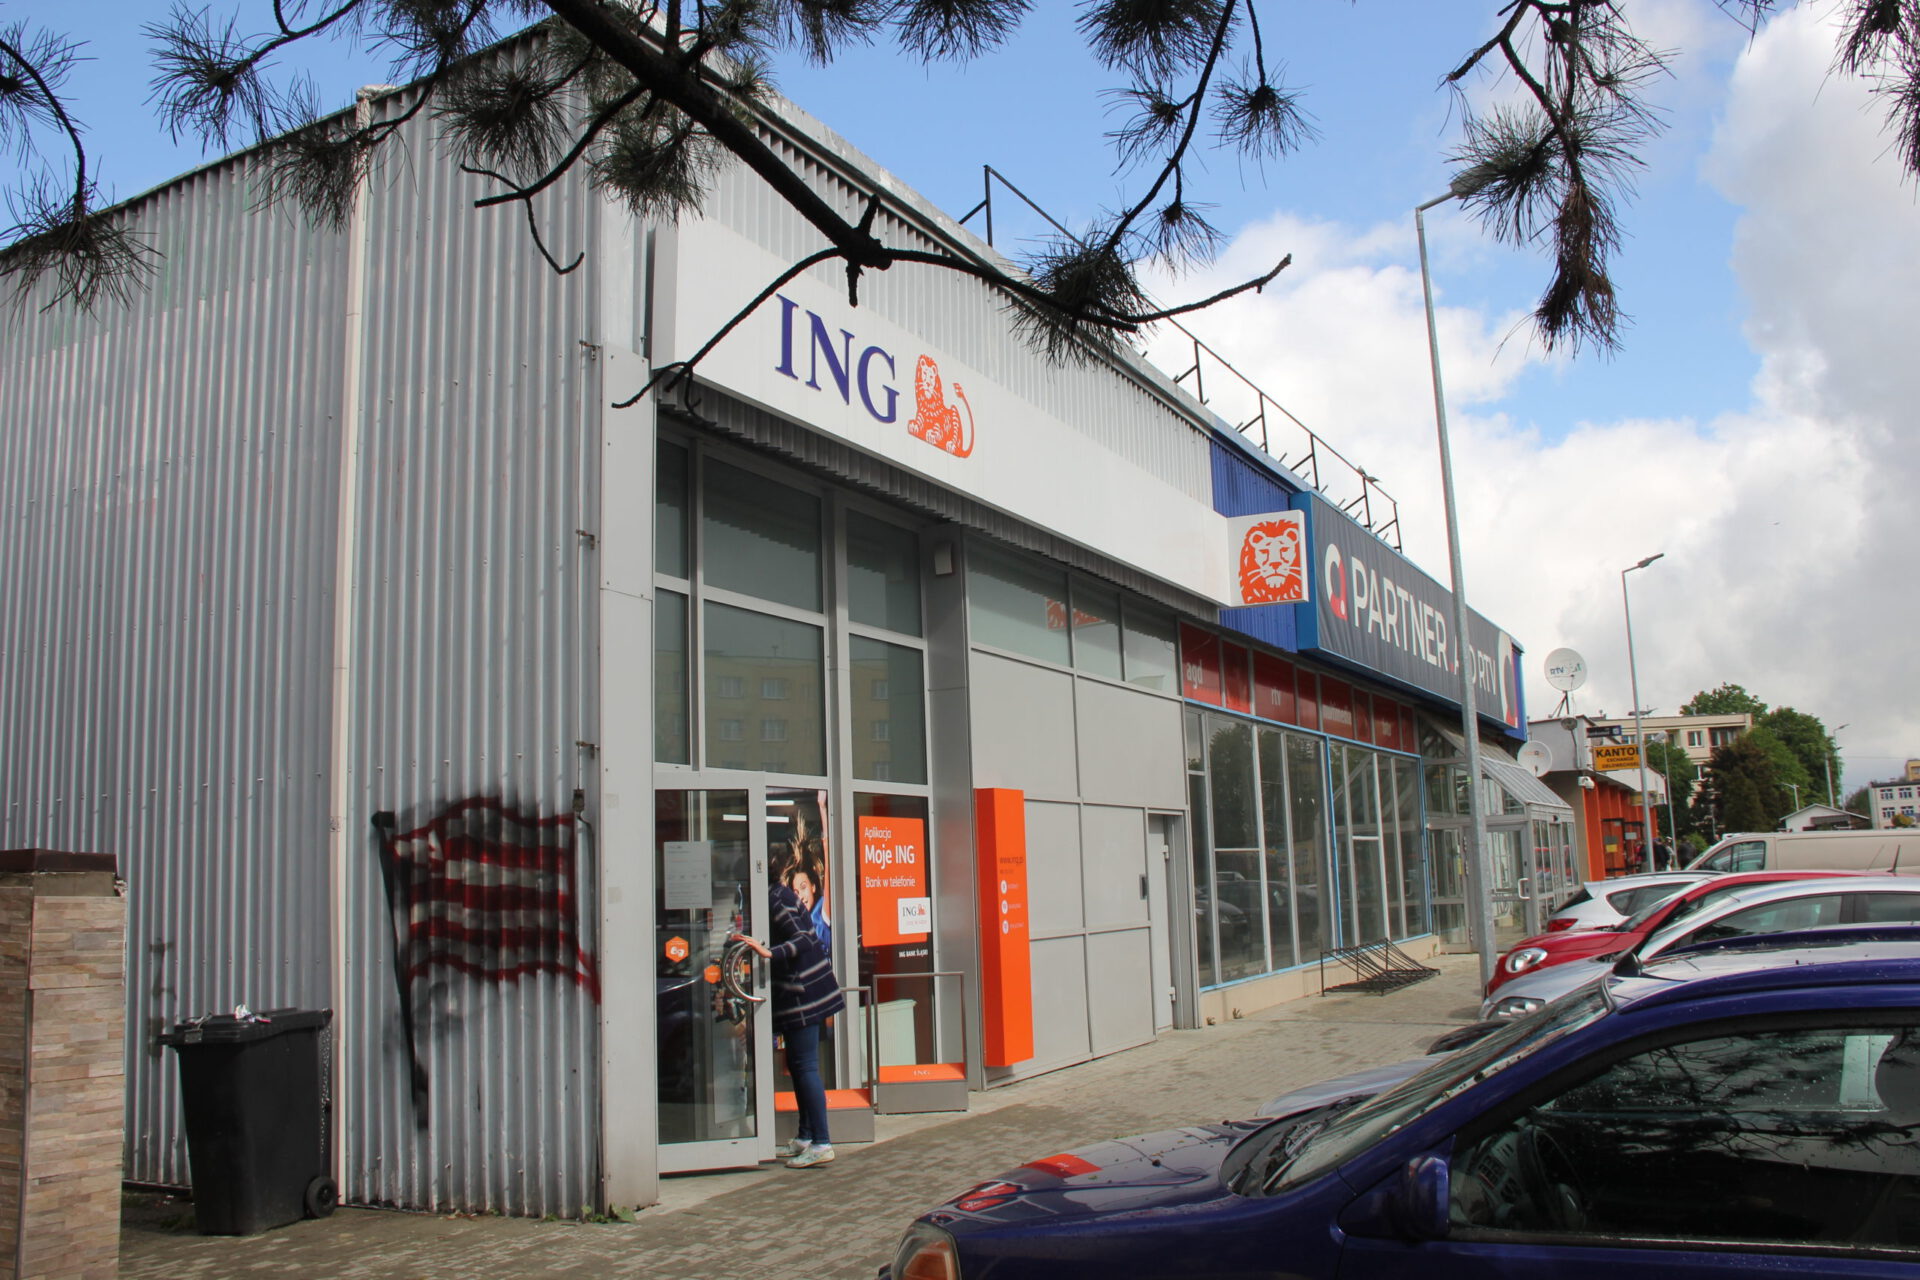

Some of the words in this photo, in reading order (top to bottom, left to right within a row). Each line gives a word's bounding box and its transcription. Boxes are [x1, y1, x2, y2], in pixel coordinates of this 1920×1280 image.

[775, 293, 900, 424] ING
[1351, 556, 1449, 672] PARTNER
[1477, 650, 1497, 696] RTV
[1186, 660, 1204, 690] agd
[864, 826, 892, 841] Aplikacja
[865, 844, 892, 870] Moje
[895, 844, 915, 864] ING
[865, 875, 881, 888] Bank
[882, 878, 889, 887] w
[889, 875, 916, 888] telefonie
[902, 906, 917, 917] ING
